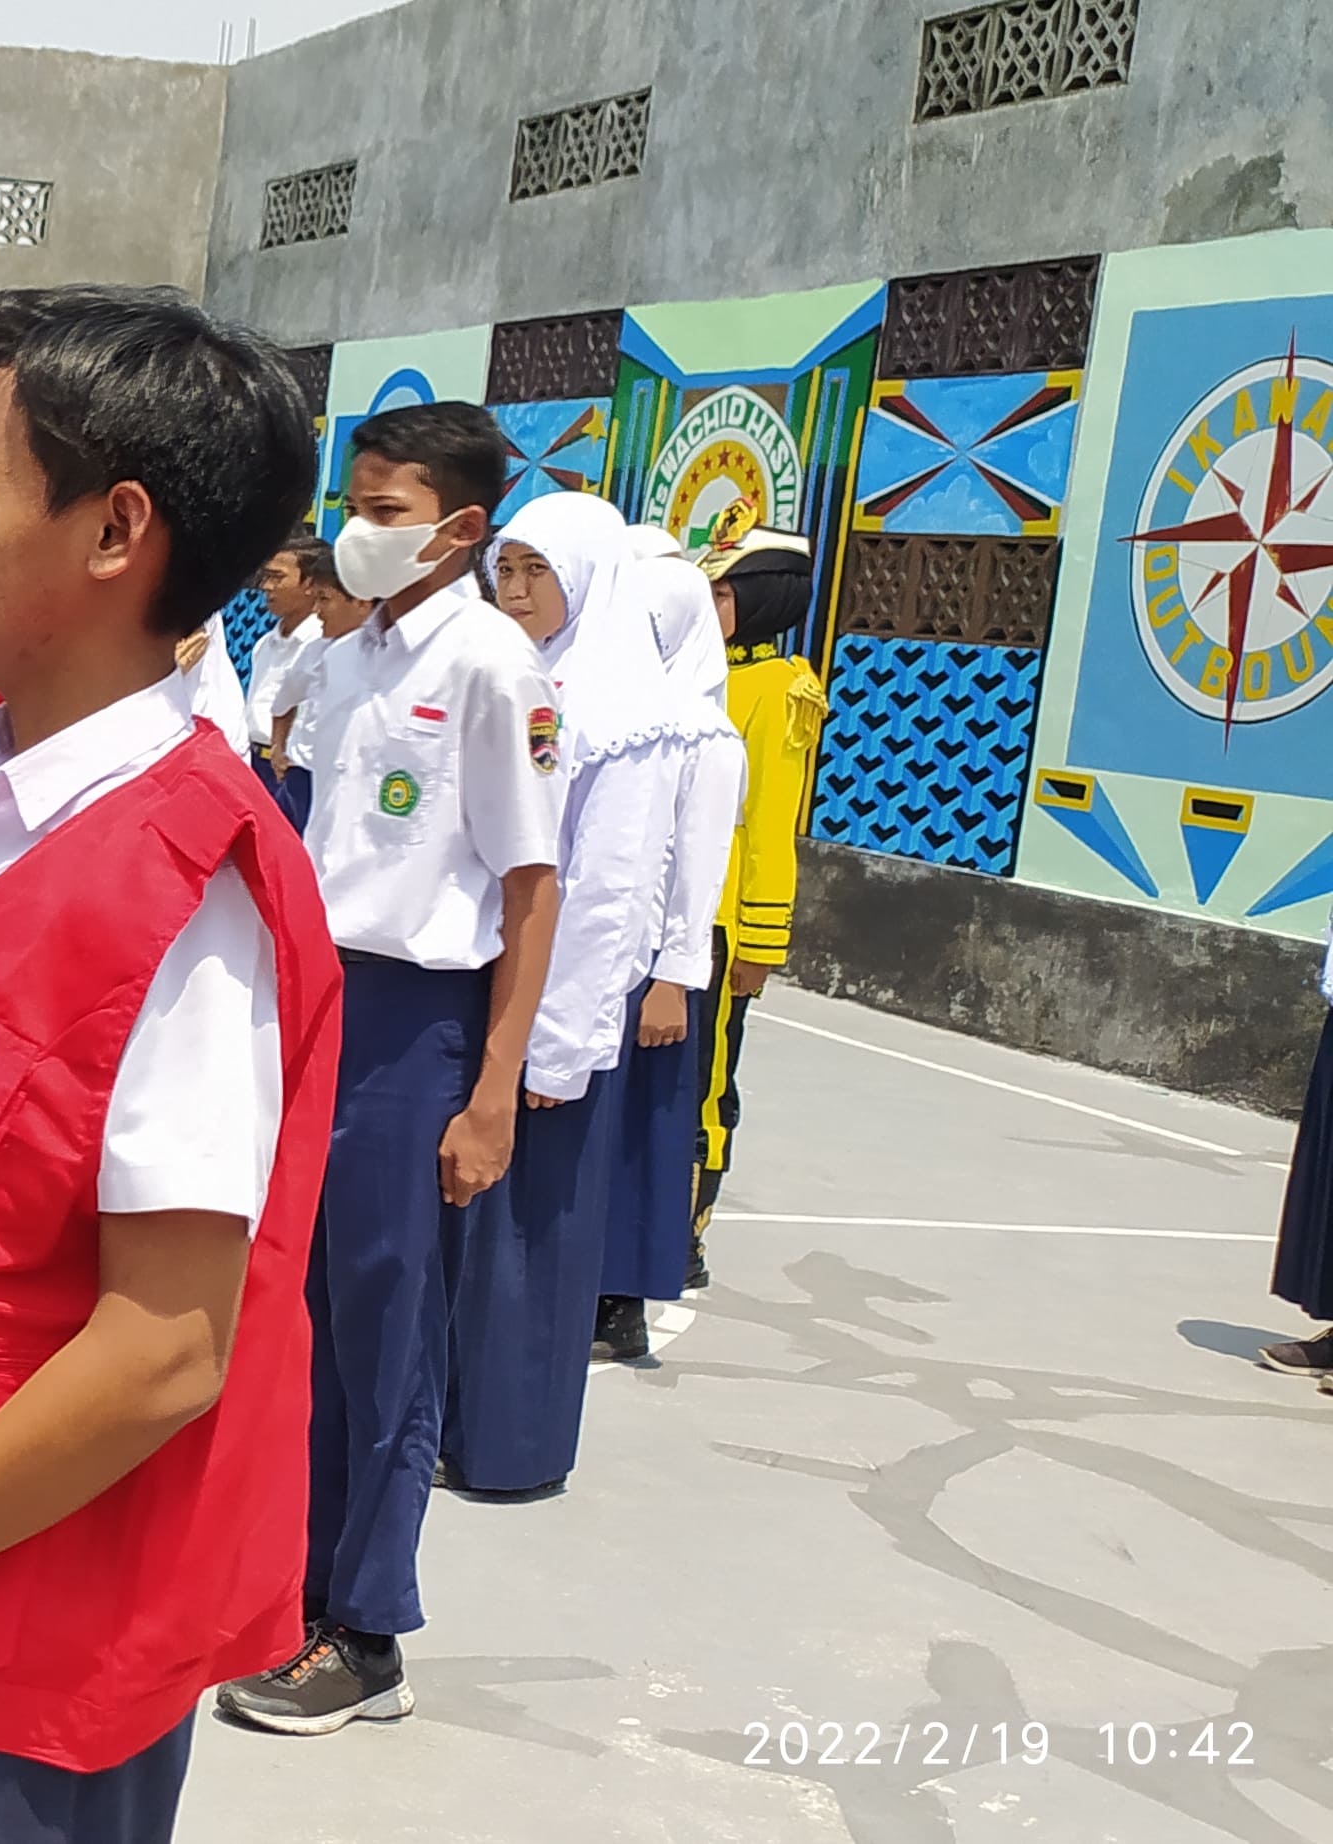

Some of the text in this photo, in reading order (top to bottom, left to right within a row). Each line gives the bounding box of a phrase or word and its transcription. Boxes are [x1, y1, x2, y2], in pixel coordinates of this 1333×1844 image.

[659, 396, 747, 478] WACHID
[746, 405, 795, 530] HASYIM
[1147, 378, 1333, 496] IKAWA
